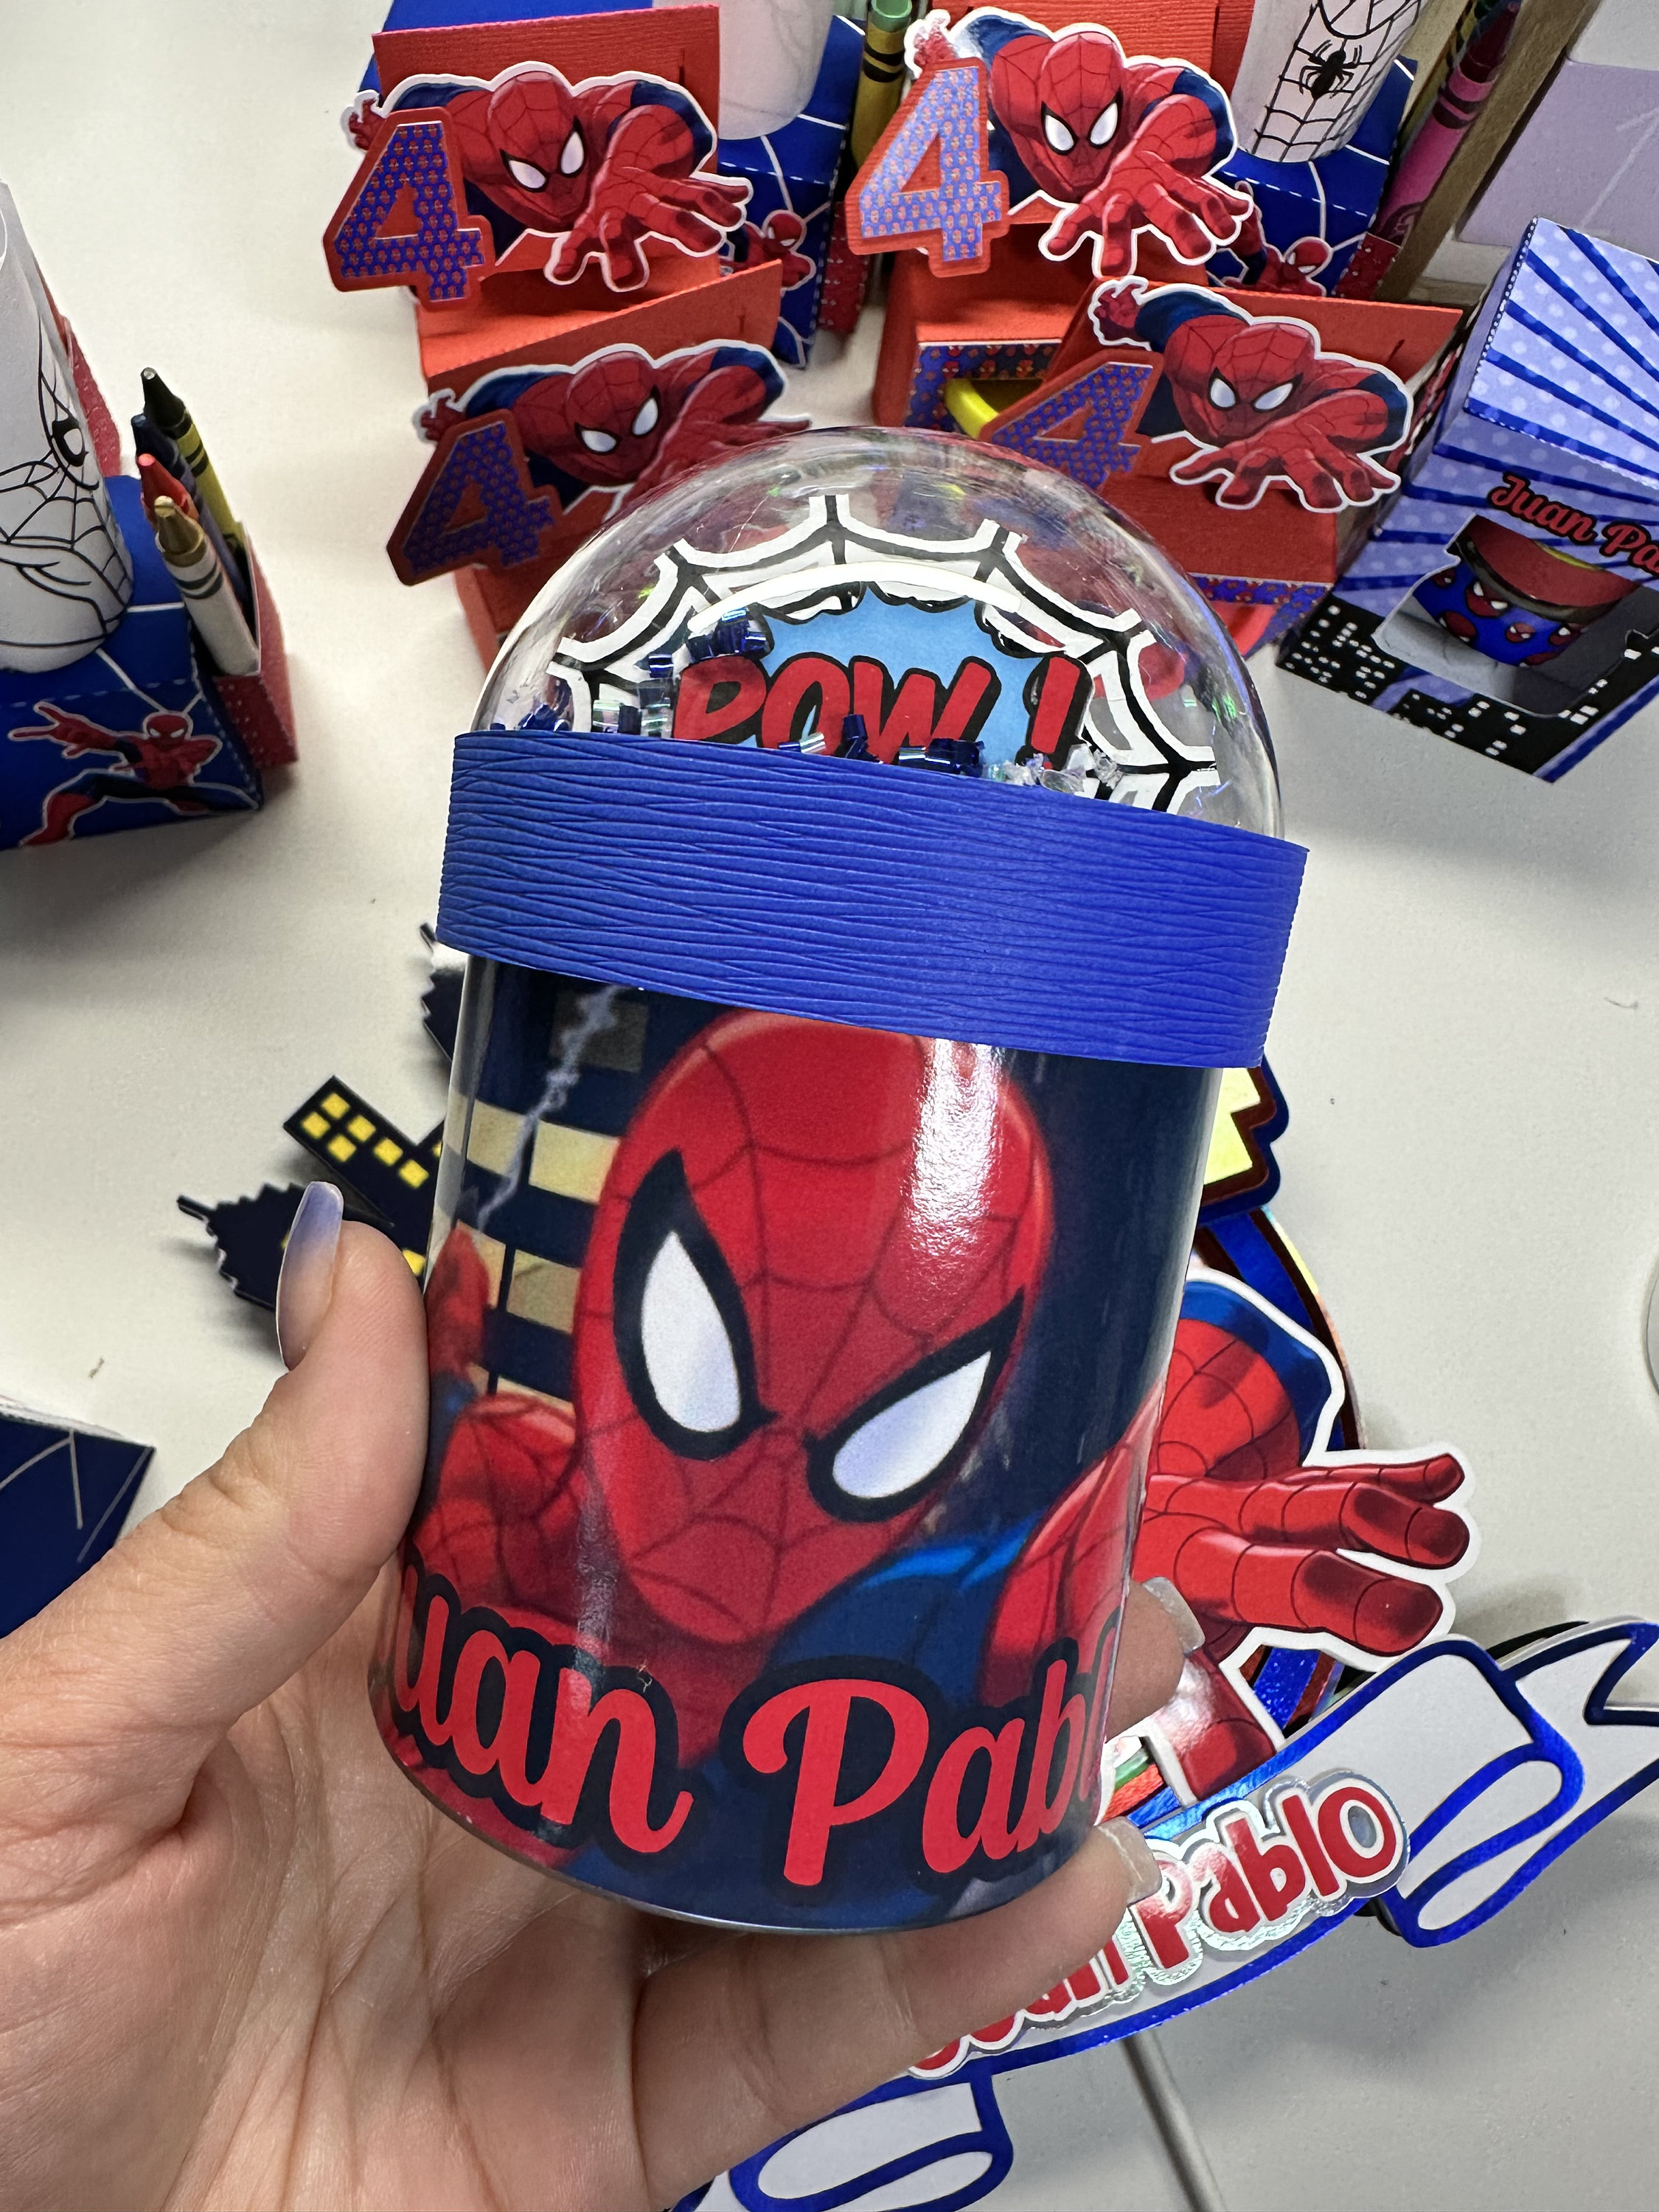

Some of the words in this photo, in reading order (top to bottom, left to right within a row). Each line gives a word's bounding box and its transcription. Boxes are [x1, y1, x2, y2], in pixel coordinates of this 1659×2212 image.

[328, 112, 490, 304] 4
[852, 62, 1006, 269] 4
[394, 417, 558, 582] 4
[984, 355, 1156, 490] 4
[1488, 472, 1597, 546] Juan
[1599, 520, 1659, 580] Pa
[392, 1563, 693, 1854] uan
[742, 1627, 1118, 1887] Pabl
[1131, 1784, 1399, 1970] Pablo
